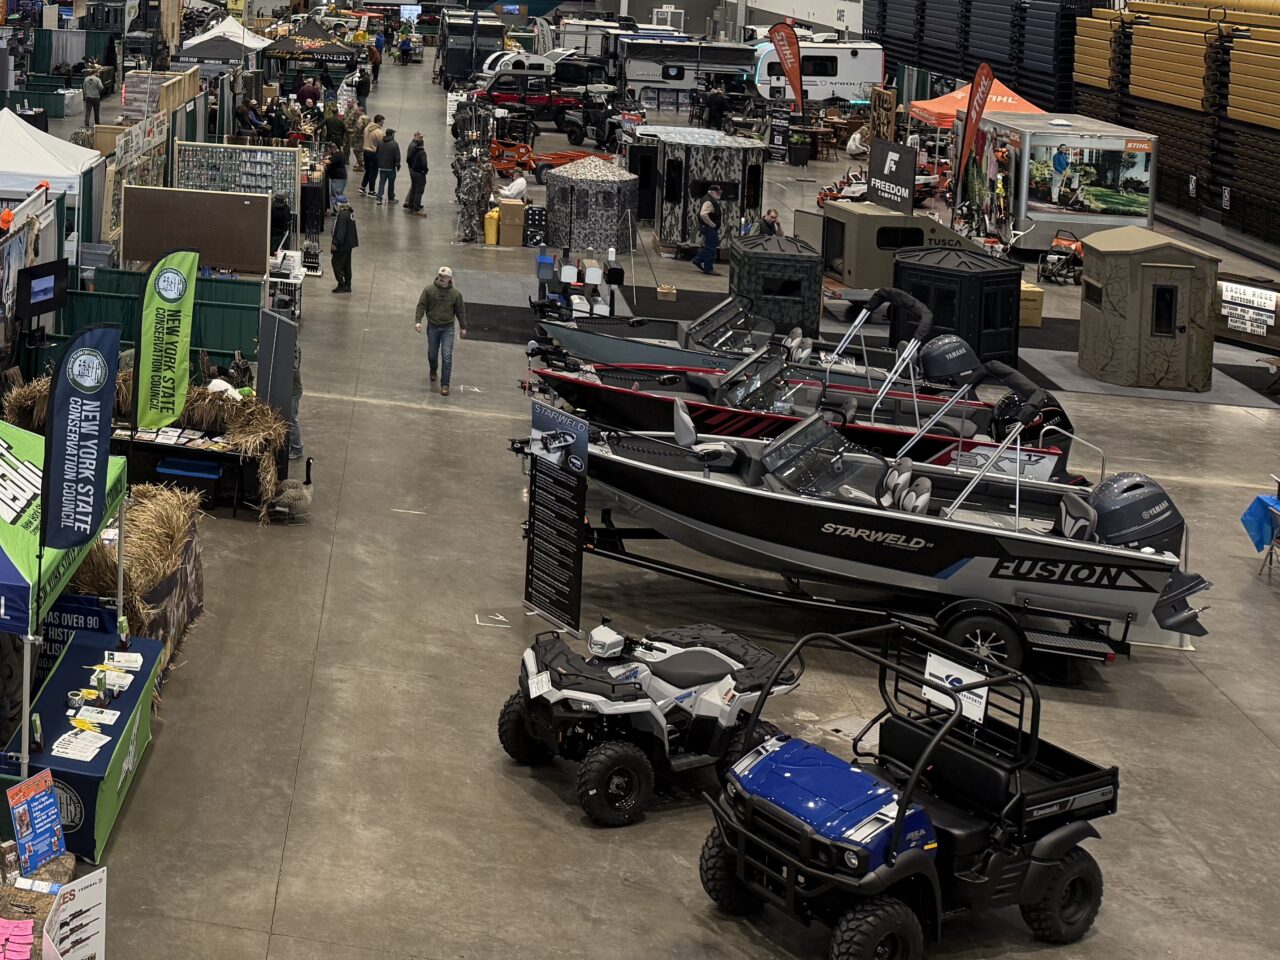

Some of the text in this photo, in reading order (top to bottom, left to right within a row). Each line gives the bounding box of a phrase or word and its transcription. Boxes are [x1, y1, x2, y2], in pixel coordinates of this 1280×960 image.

[313, 52, 352, 61] WINERY
[774, 31, 799, 68] STIHL
[970, 75, 991, 123] STIHL
[985, 95, 1018, 104] TIHL
[870, 177, 910, 200] FREEDOM
[877, 190, 902, 203] CAMPERS
[927, 238, 962, 247] TUSCA
[1225, 285, 1273, 302] EAGLE RIDGE
[1230, 295, 1255, 305] OUTDOORS
[165, 308, 181, 338] NEW
[149, 307, 166, 412] CONSERVATION COUNCIL
[162, 338, 179, 373] YORK
[944, 347, 968, 361] YAMAHA
[159, 374, 176, 415] STATE
[81, 399, 101, 436] NEW
[534, 404, 586, 433] STARWELD
[60, 396, 82, 529] CONSERVATION COUNCIL
[79, 440, 99, 480] YORK
[1026, 452, 1046, 463] 17
[74, 481, 95, 535] STATE
[1147, 500, 1170, 519] YAMAHA
[820, 521, 926, 550] STARWELD
[993, 558, 1122, 588] FUSION
[61, 613, 100, 629] OVER 90
